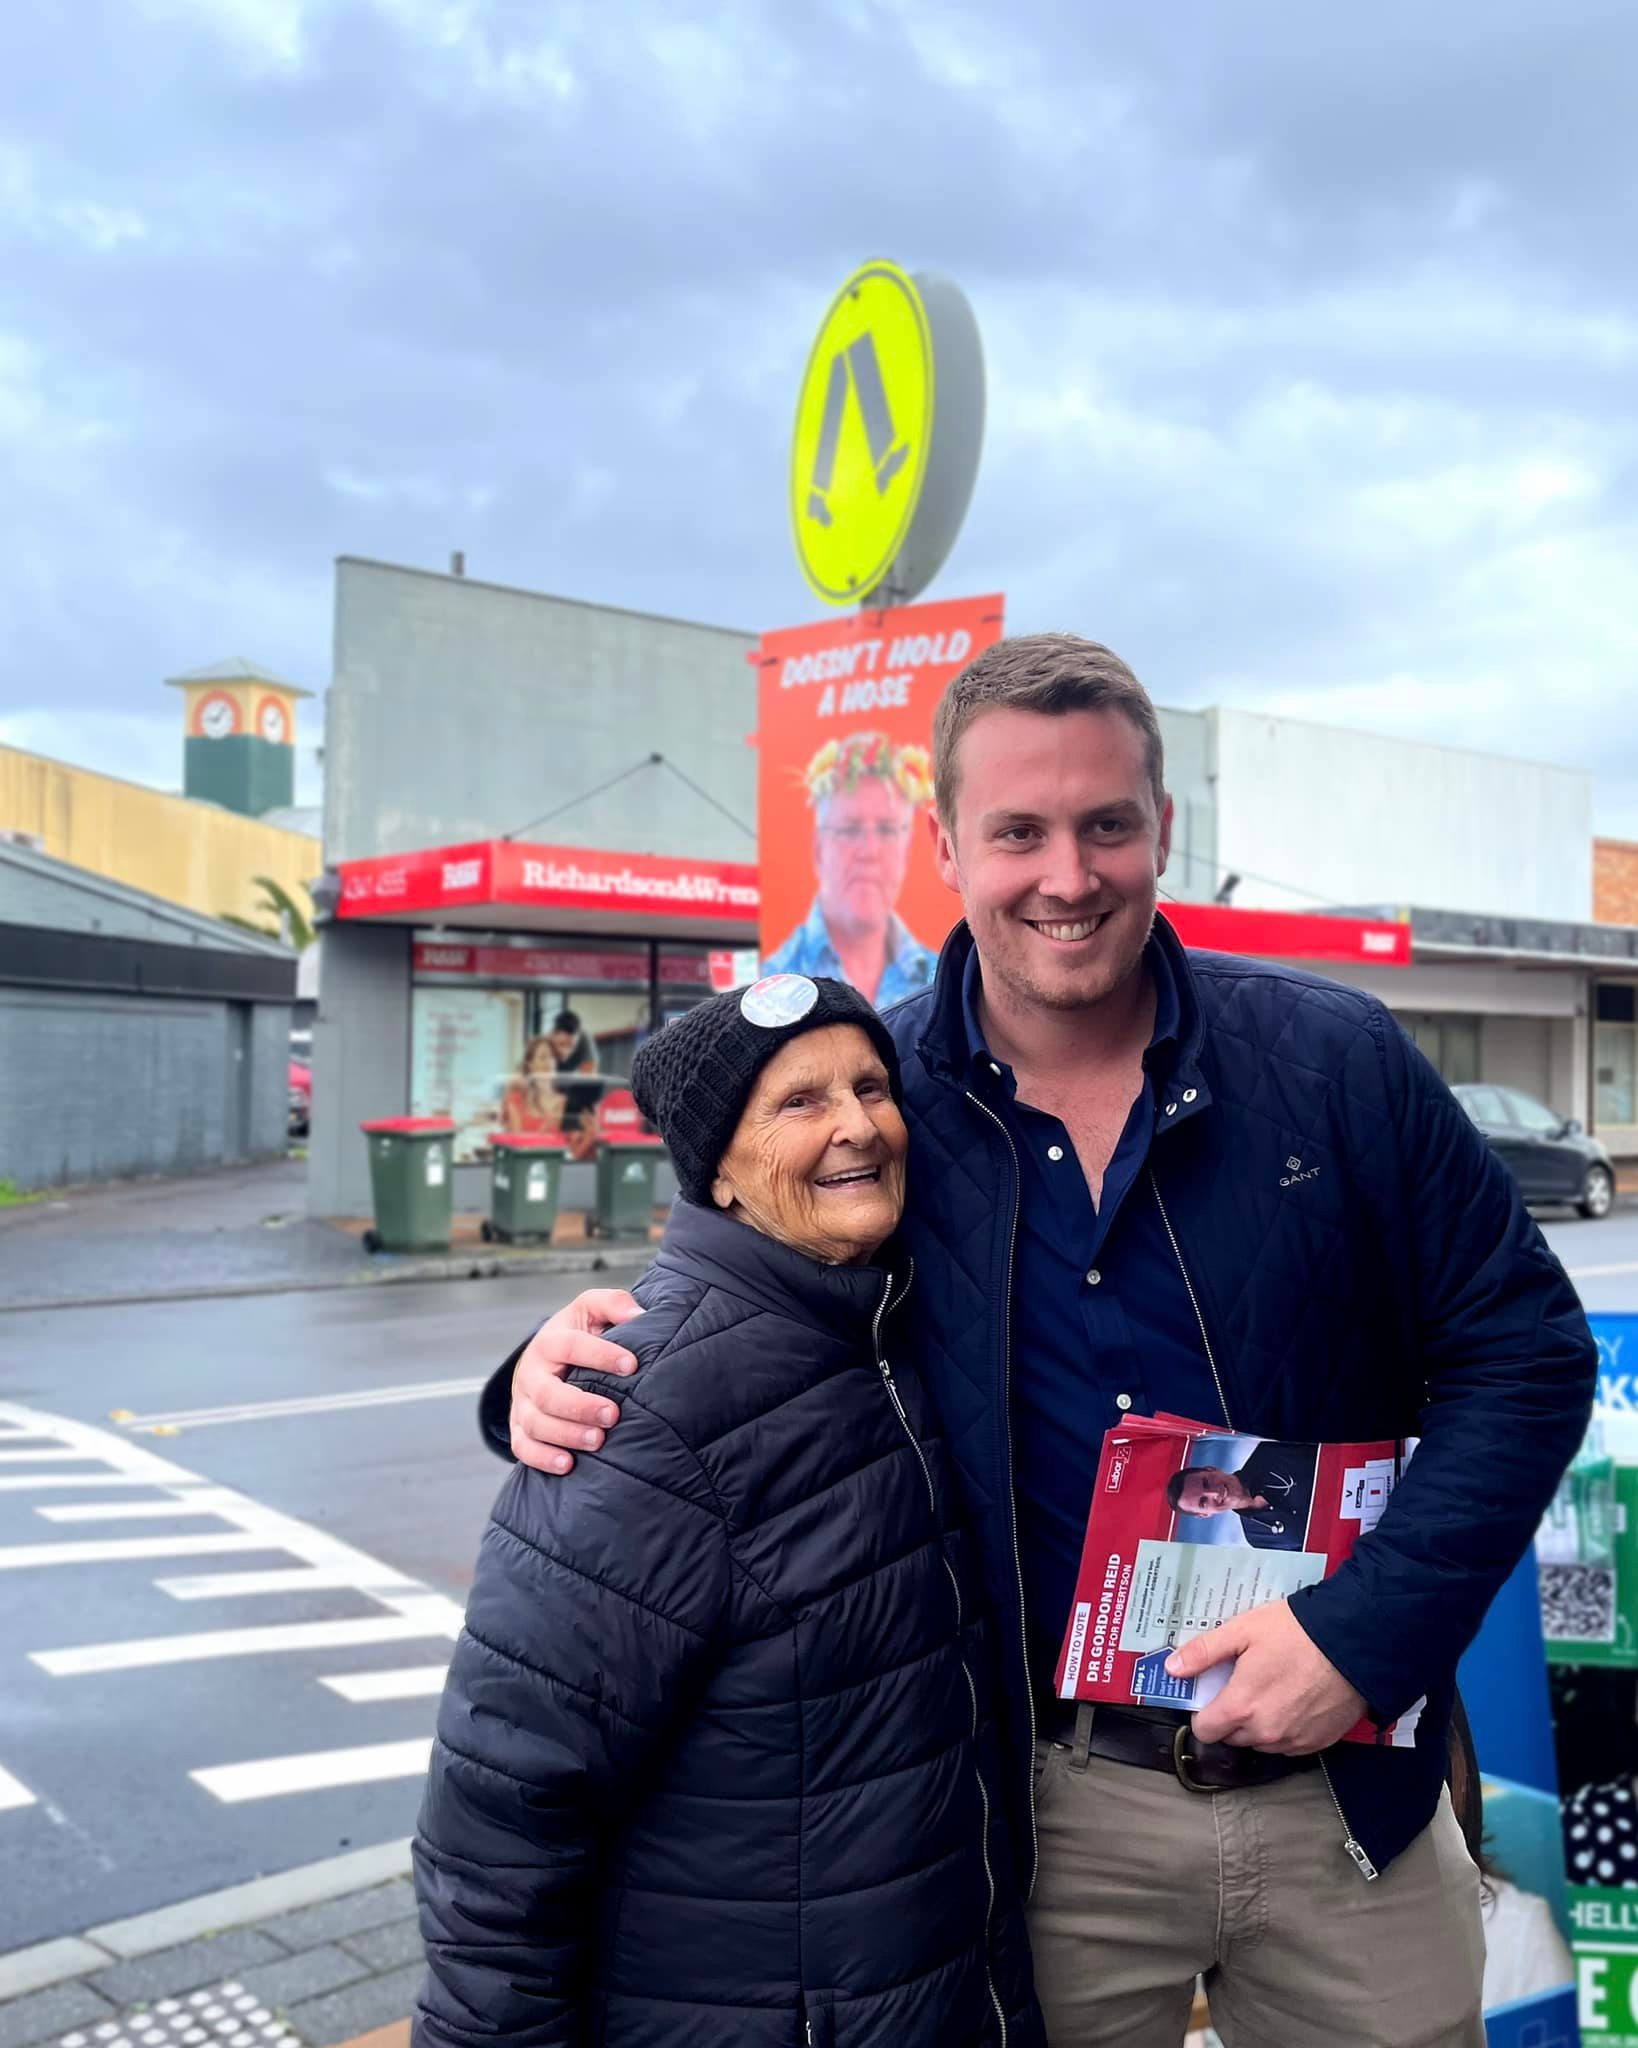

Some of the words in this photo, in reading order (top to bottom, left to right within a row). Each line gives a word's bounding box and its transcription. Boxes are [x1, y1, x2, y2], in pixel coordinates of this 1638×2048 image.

[780, 639, 883, 688] DOESN'T
[887, 629, 971, 669] HOLD
[817, 684, 836, 718] A
[839, 673, 914, 714] HOSE
[1280, 1167, 1320, 1187] GANT
[1108, 1461, 1122, 1489] Labor
[1104, 1554, 1120, 1589] REID
[1113, 1564, 1132, 1625] ROBERTSON
[1074, 1611, 1087, 1637] VOTE
[1091, 1592, 1113, 1658] GORDON
[1109, 1625, 1119, 1646] FOR
[1071, 1640, 1081, 1656] TO
[1067, 1656, 1079, 1680] HOW
[1087, 1660, 1100, 1682] DR
[1102, 1649, 1115, 1683] LABOR
[1134, 1672, 1146, 1693] Step
